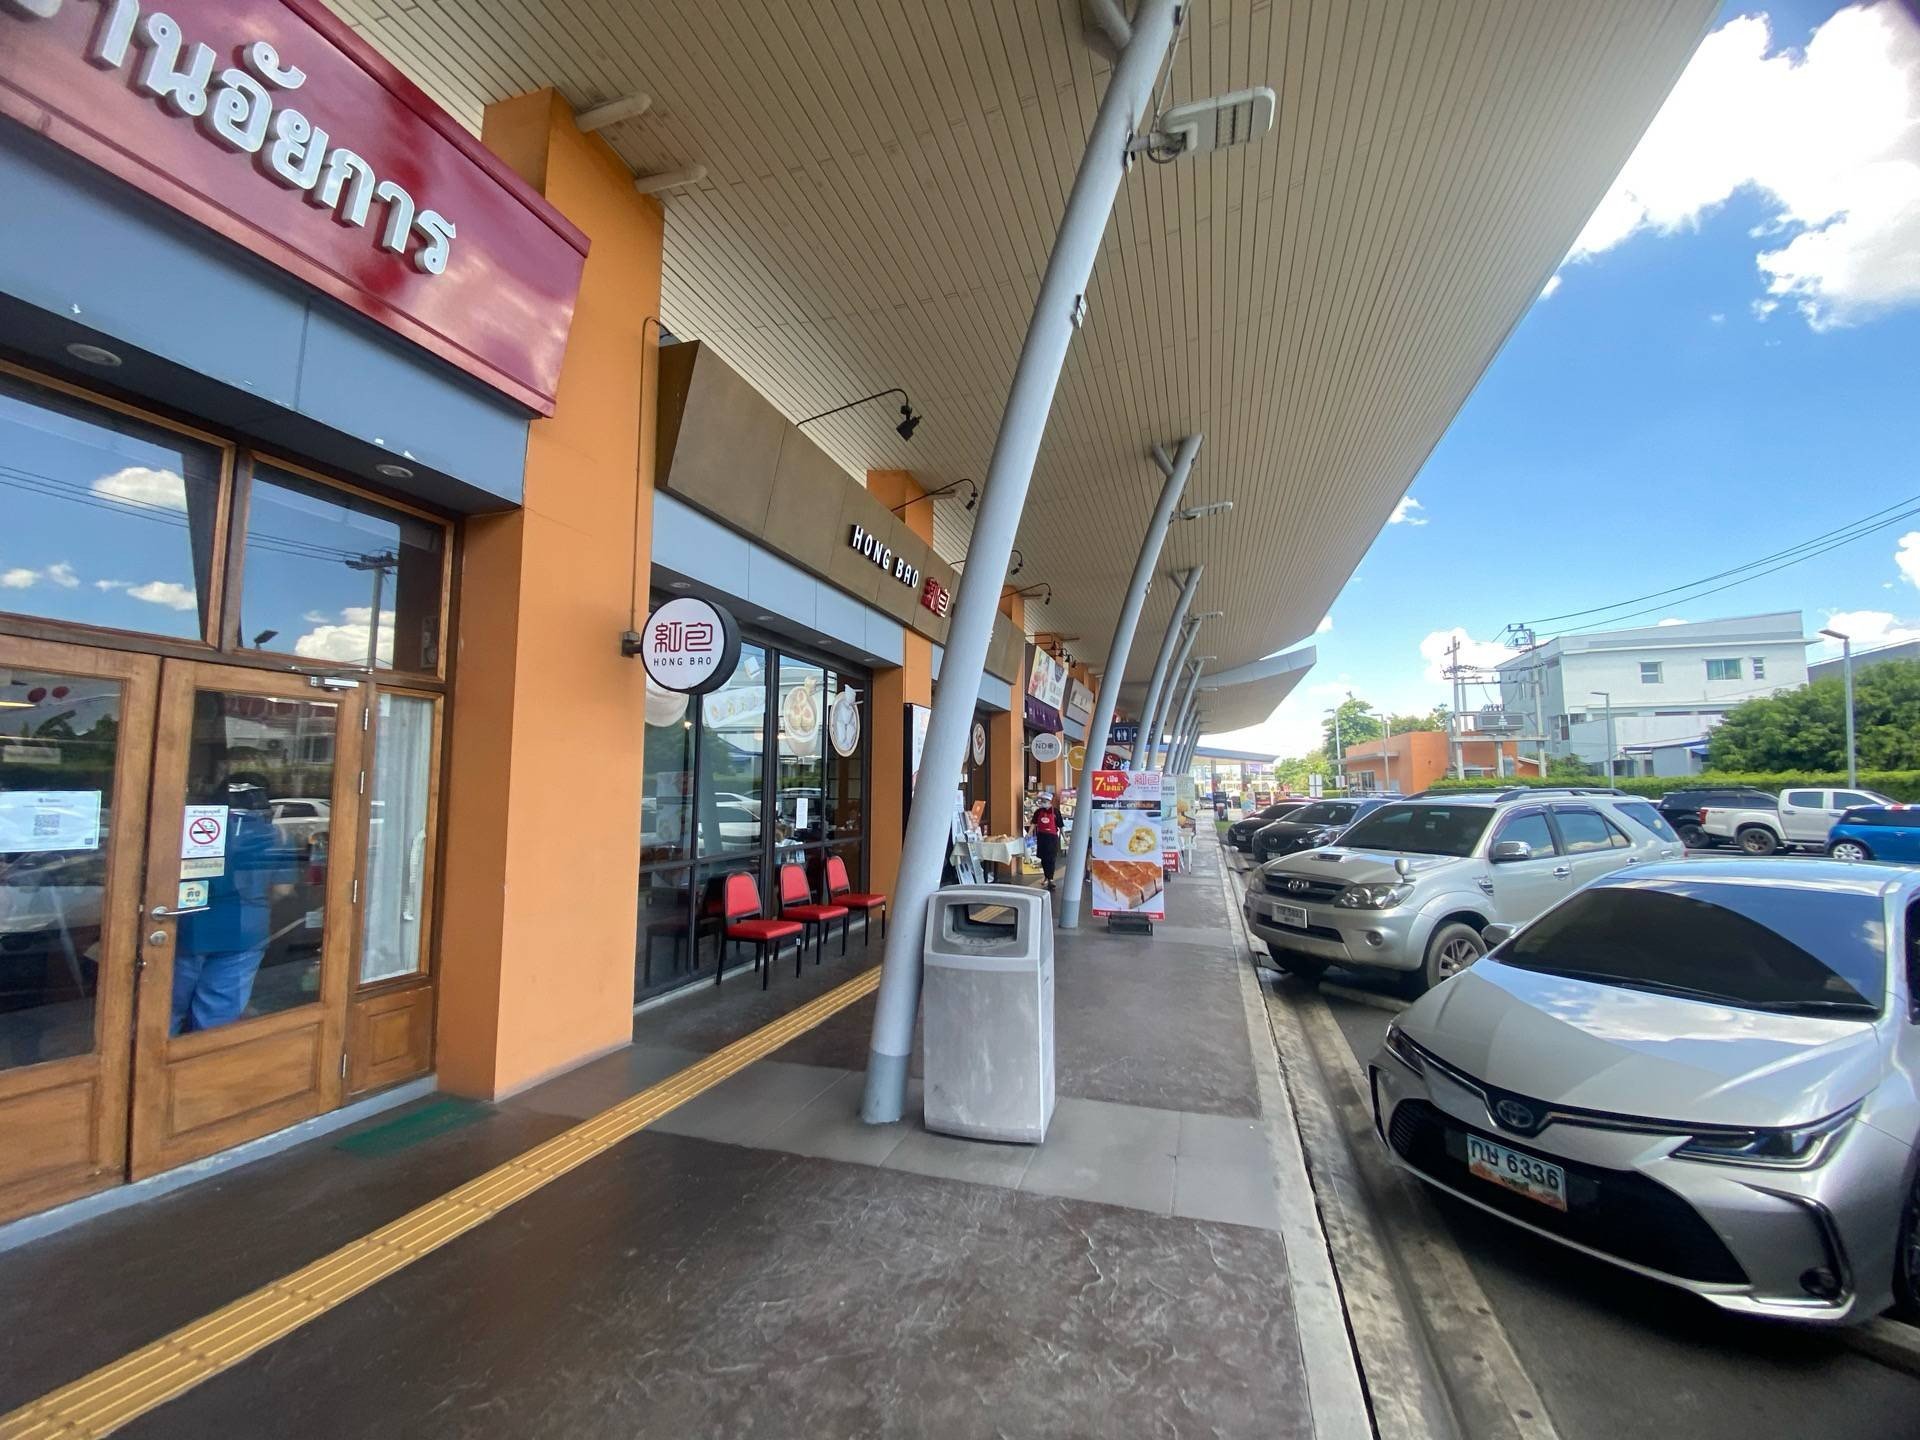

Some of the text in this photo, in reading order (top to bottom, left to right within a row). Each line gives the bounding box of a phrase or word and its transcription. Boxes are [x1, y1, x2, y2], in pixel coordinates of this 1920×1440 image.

[15, 0, 457, 275] านอัยการ
[851, 524, 919, 588] HONG BAO
[653, 656, 712, 666] HONG BAO
[1094, 776, 1105, 791] 7
[1507, 1153, 1560, 1190] 6336
